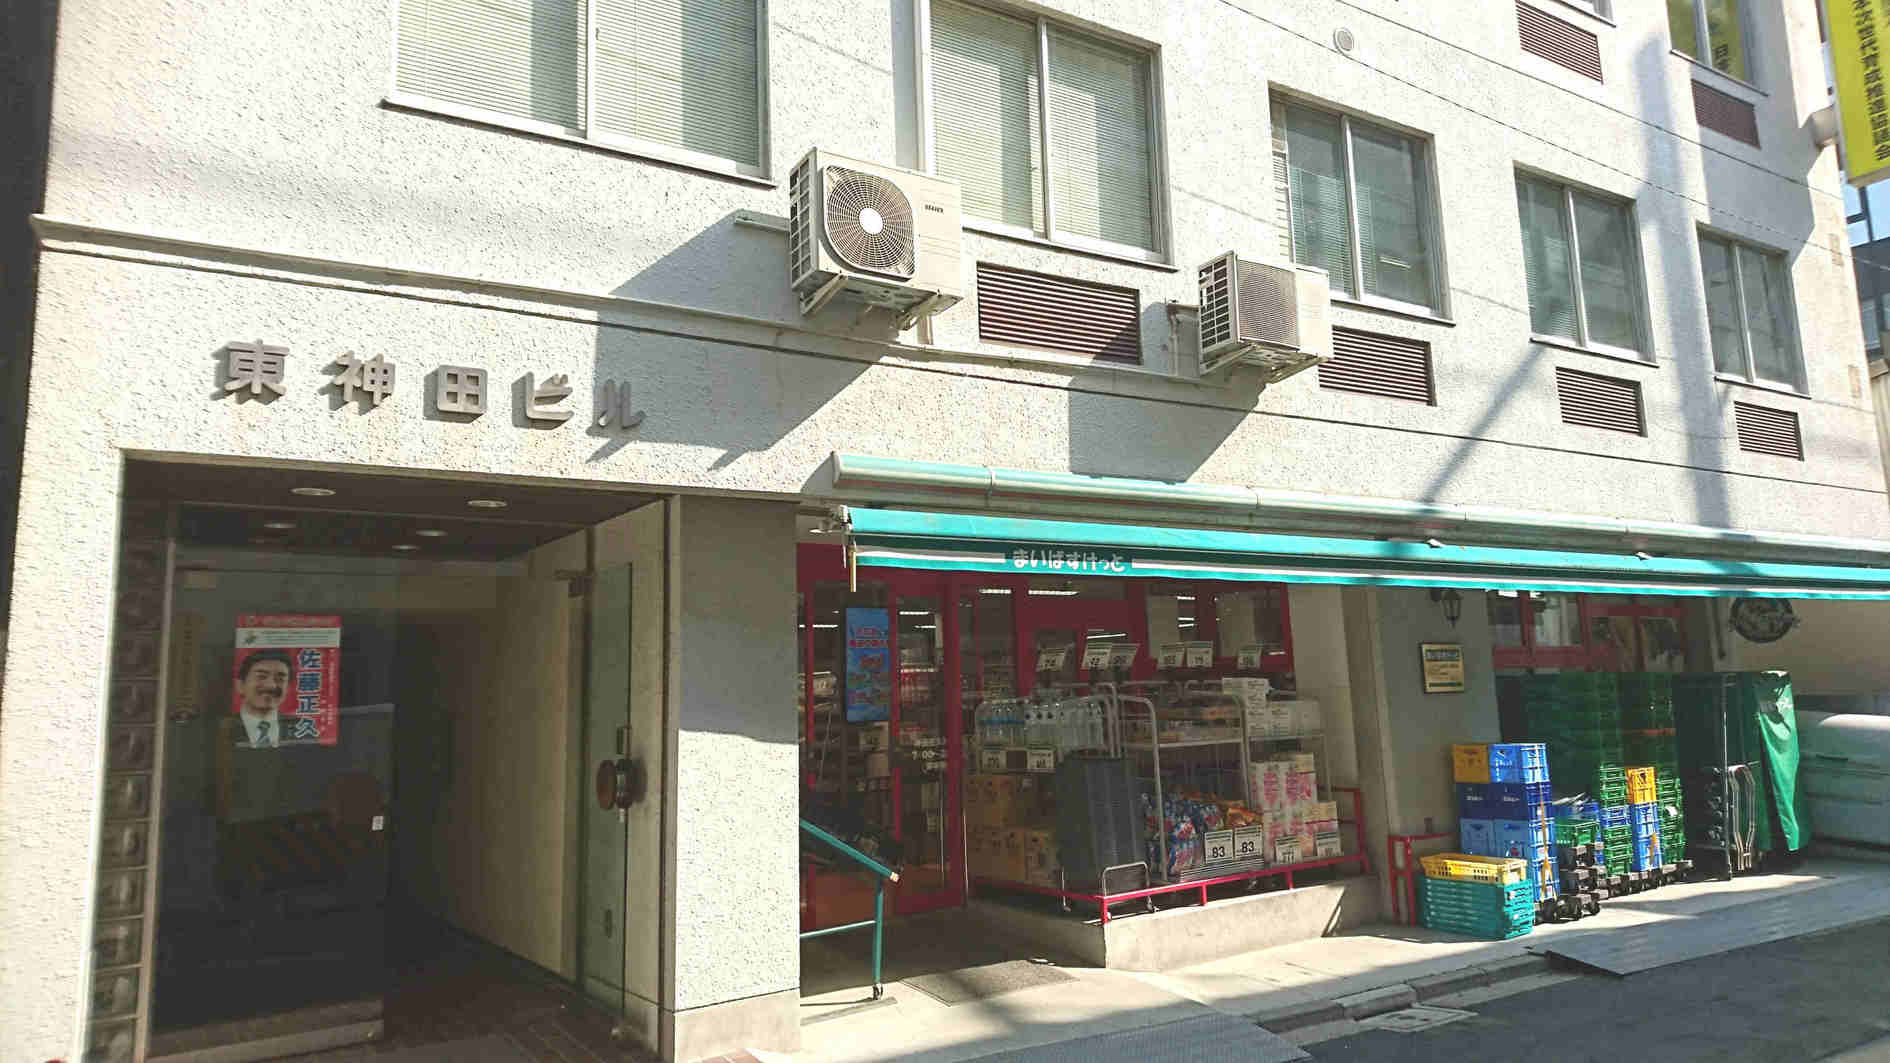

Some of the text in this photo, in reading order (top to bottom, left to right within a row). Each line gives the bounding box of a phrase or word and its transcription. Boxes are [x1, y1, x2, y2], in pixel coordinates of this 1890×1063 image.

[225, 339, 646, 429] 東神田ビル
[1012, 548, 1126, 572] まいばすけっと
[1241, 841, 1255, 853] 83
